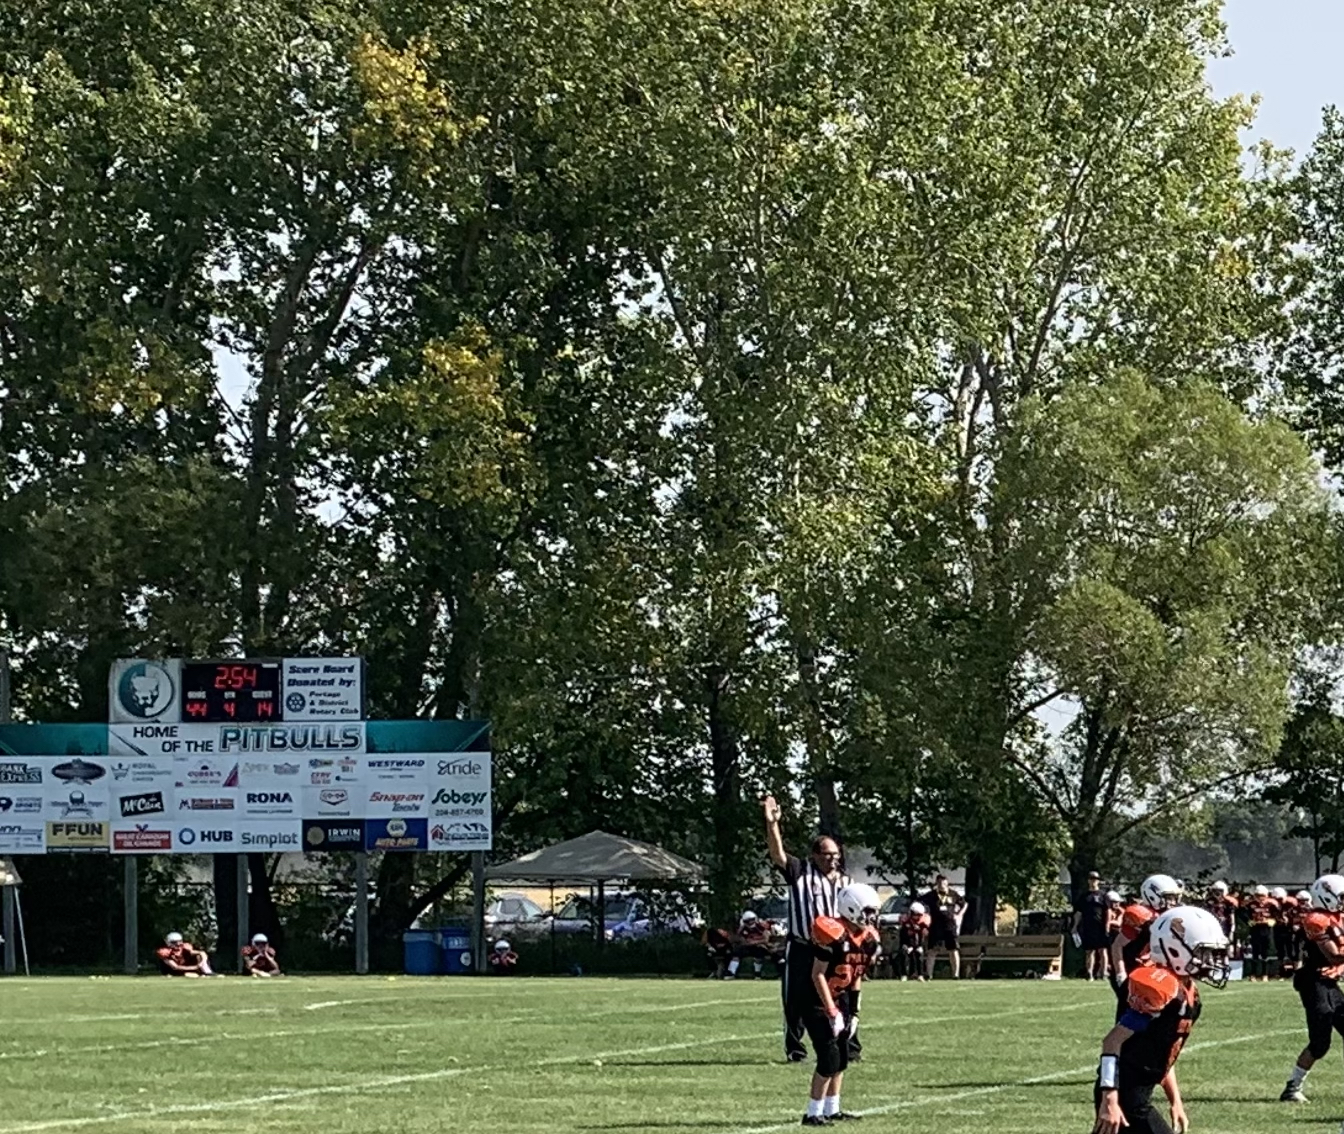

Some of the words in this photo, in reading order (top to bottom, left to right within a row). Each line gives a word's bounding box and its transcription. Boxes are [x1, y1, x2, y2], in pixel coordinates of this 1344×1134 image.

[133, 726, 179, 738] HOME
[219, 725, 363, 753] PITBULLS
[162, 741, 184, 753] OF
[185, 741, 214, 753] THE
[437, 758, 482, 775] Stride
[246, 793, 293, 803] RONA
[431, 788, 488, 806] Sobeys
[52, 823, 102, 836] FFUN
[328, 828, 361, 837] IRWIN
[201, 831, 233, 842] HUB
[241, 832, 298, 848] Simplot
